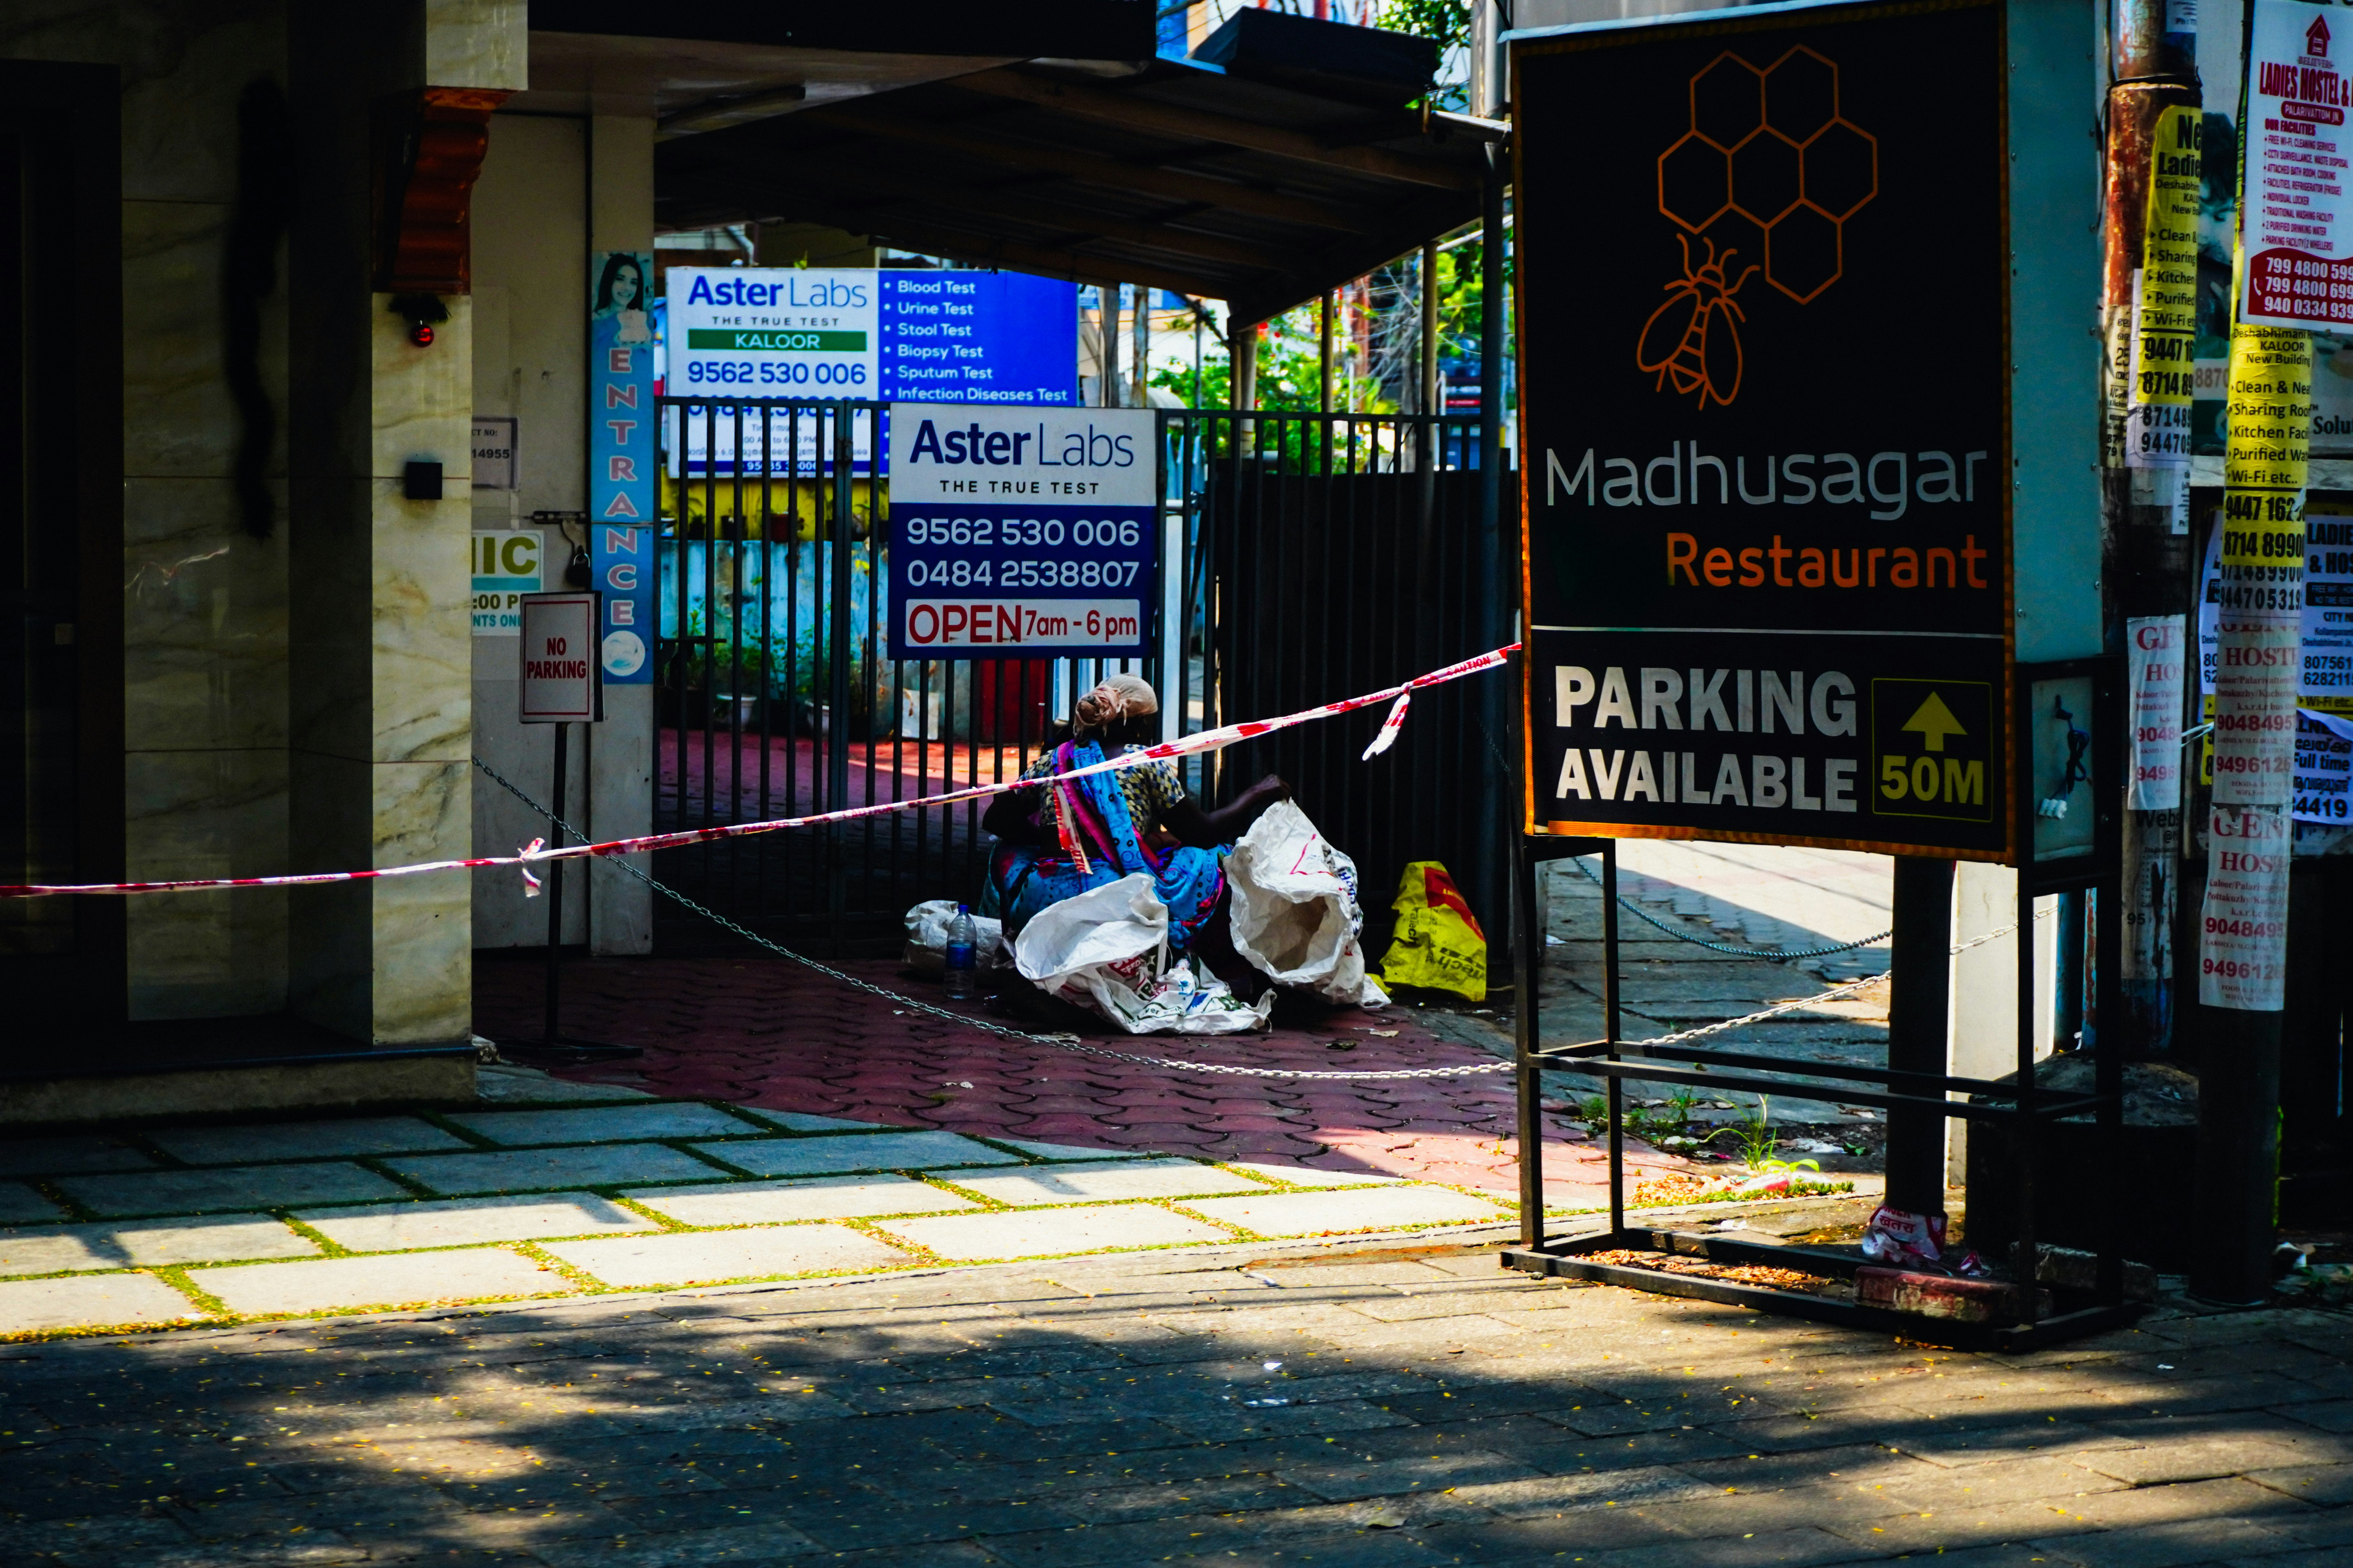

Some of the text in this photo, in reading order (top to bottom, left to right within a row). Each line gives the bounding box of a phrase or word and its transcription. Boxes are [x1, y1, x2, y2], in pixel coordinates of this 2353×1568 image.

[2260, 61, 2349, 107] LADIES HOSTEL &
[2285, 104, 2330, 120] PALARIVATTOM
[2265, 118, 2316, 136] OUR FACILITIES
[2268, 135, 2279, 144] FREE
[2267, 163, 2290, 174] ATTACHED
[2267, 192, 2310, 205] INDIVIDUAL LOCKER
[2172, 204, 2191, 214] New
[2267, 206, 2334, 223] TRADITIONAL WASHING FACILITY
[2159, 228, 2191, 242] Clean
[2270, 221, 2290, 232] PURIFIED
[2291, 223, 2311, 234] DRINKING
[2312, 226, 2326, 236] WATER
[2266, 235, 2285, 246] PARKING
[2157, 249, 2196, 266] Sharing
[2267, 257, 2292, 274] 799
[2294, 260, 2328, 278] 4800
[2157, 270, 2195, 285] Kitchen
[688, 275, 867, 308] Aster Labs
[898, 280, 976, 294] Blood Test
[2265, 276, 2290, 293] 799
[2293, 279, 2327, 297] 4800
[898, 302, 974, 315] Urine Test
[2264, 296, 2291, 313] 940
[2294, 299, 2328, 316] 0334
[712, 316, 840, 326] THE TRUE TEST
[2154, 313, 2185, 326] Wi-Fi
[898, 322, 972, 336] Stool Test
[2233, 328, 2306, 338] Deshabhimani
[735, 333, 821, 349] KALOOR
[2145, 337, 2183, 361] 9447
[2260, 340, 2305, 352] KALOOR
[898, 344, 983, 360] Biopsy Test
[2247, 353, 2310, 368] New Building
[688, 361, 866, 384] 9562 530 006
[898, 365, 993, 381] Sputum Test
[2143, 371, 2179, 395] 8714
[2236, 380, 2272, 393] Clean
[2277, 381, 2288, 394] &
[898, 387, 1068, 401] Infection Diseases Test
[2235, 403, 2285, 419] Sharing
[484, 428, 498, 437] NO:
[2234, 425, 2285, 439] Kitchen
[909, 419, 1134, 467] Aster Labs
[472, 448, 510, 459] 14955
[2233, 447, 2286, 461] Purified
[1546, 439, 1988, 520] Madhusagar
[2232, 470, 2265, 483] Wi-Fi
[605, 348, 639, 625] ENTRANCE
[940, 480, 1100, 494] THE TRUE TEST
[2226, 496, 2263, 520] 9447
[907, 518, 1139, 546] 9562 530 006
[2224, 531, 2258, 556] 8714
[1667, 532, 1988, 589] Restaurant
[2309, 555, 2322, 573] &
[907, 560, 1139, 587] 0484 2538807
[909, 604, 1022, 644] OPEN
[1025, 610, 1067, 635] 7am
[547, 638, 566, 656] NO
[527, 660, 586, 679] PARKING
[1555, 665, 1857, 737] PARKING
[2319, 755, 2350, 772] time
[1556, 748, 1857, 813] AVAILABLE
[1880, 755, 1984, 805] 50M
